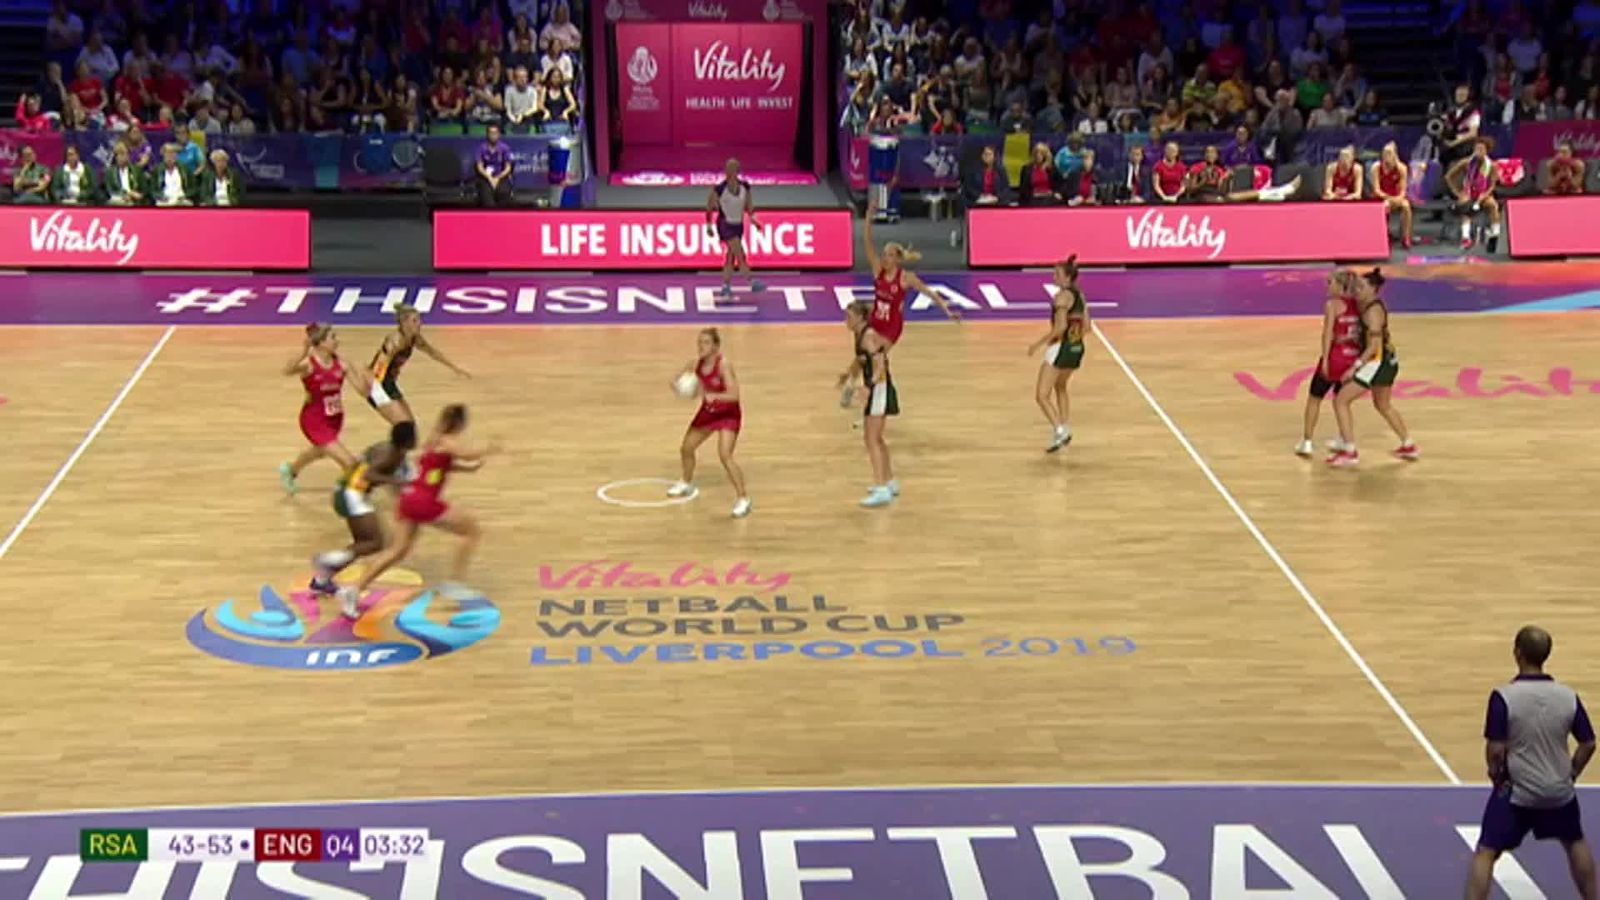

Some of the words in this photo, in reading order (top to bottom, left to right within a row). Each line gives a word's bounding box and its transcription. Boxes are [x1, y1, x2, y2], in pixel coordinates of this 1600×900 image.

[694, 40, 785, 91] Vitality
[686, 97, 725, 109] HEALTH
[731, 97, 752, 109] LIFE
[758, 97, 793, 109] INVEST
[30, 210, 138, 264] Vitality
[541, 224, 607, 256] LIFE
[620, 223, 815, 256] INSURNCE
[1126, 209, 1226, 259] Vitality
[1233, 366, 1600, 401] Valit
[538, 560, 792, 595] Vitality
[538, 594, 848, 615] NETBALL
[535, 616, 808, 639] WORLD
[826, 614, 965, 634] CUP
[529, 639, 964, 666] LIVERPOOL
[983, 636, 1138, 657] 2019
